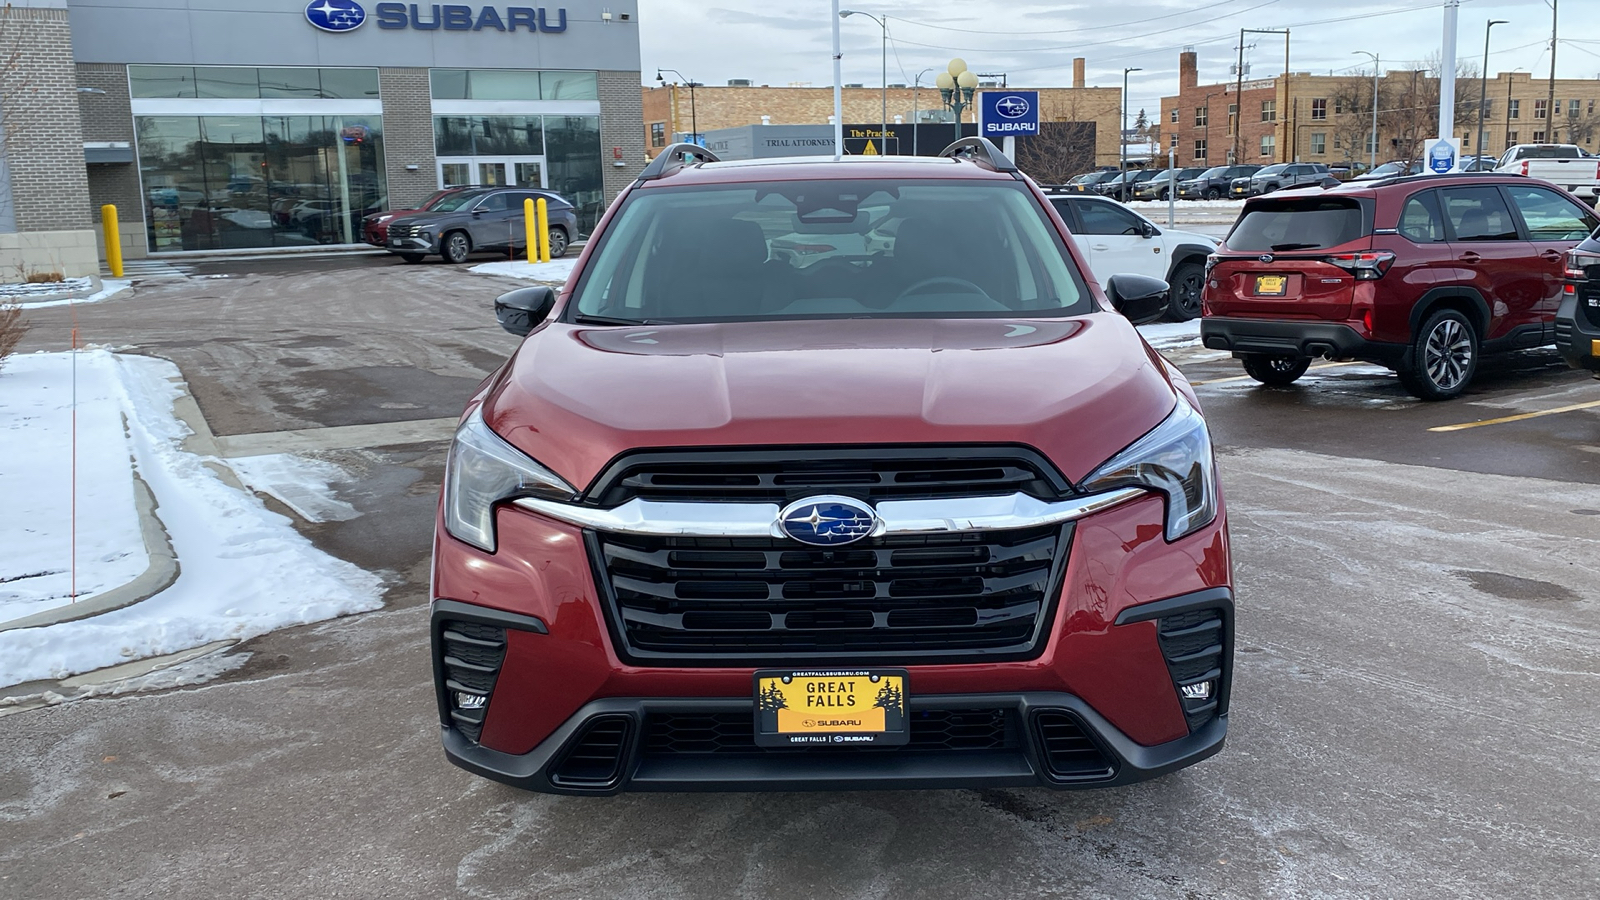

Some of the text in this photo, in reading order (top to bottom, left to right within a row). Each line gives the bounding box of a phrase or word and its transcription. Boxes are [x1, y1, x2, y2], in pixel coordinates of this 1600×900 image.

[375, 2, 567, 33] SUBARU
[987, 122, 1035, 132] SUBARU
[850, 129, 895, 137] The Pracice
[766, 139, 836, 147] TRIAL ATTORNEYS
[806, 682, 856, 693] GREAT
[806, 695, 856, 707] FALLS
